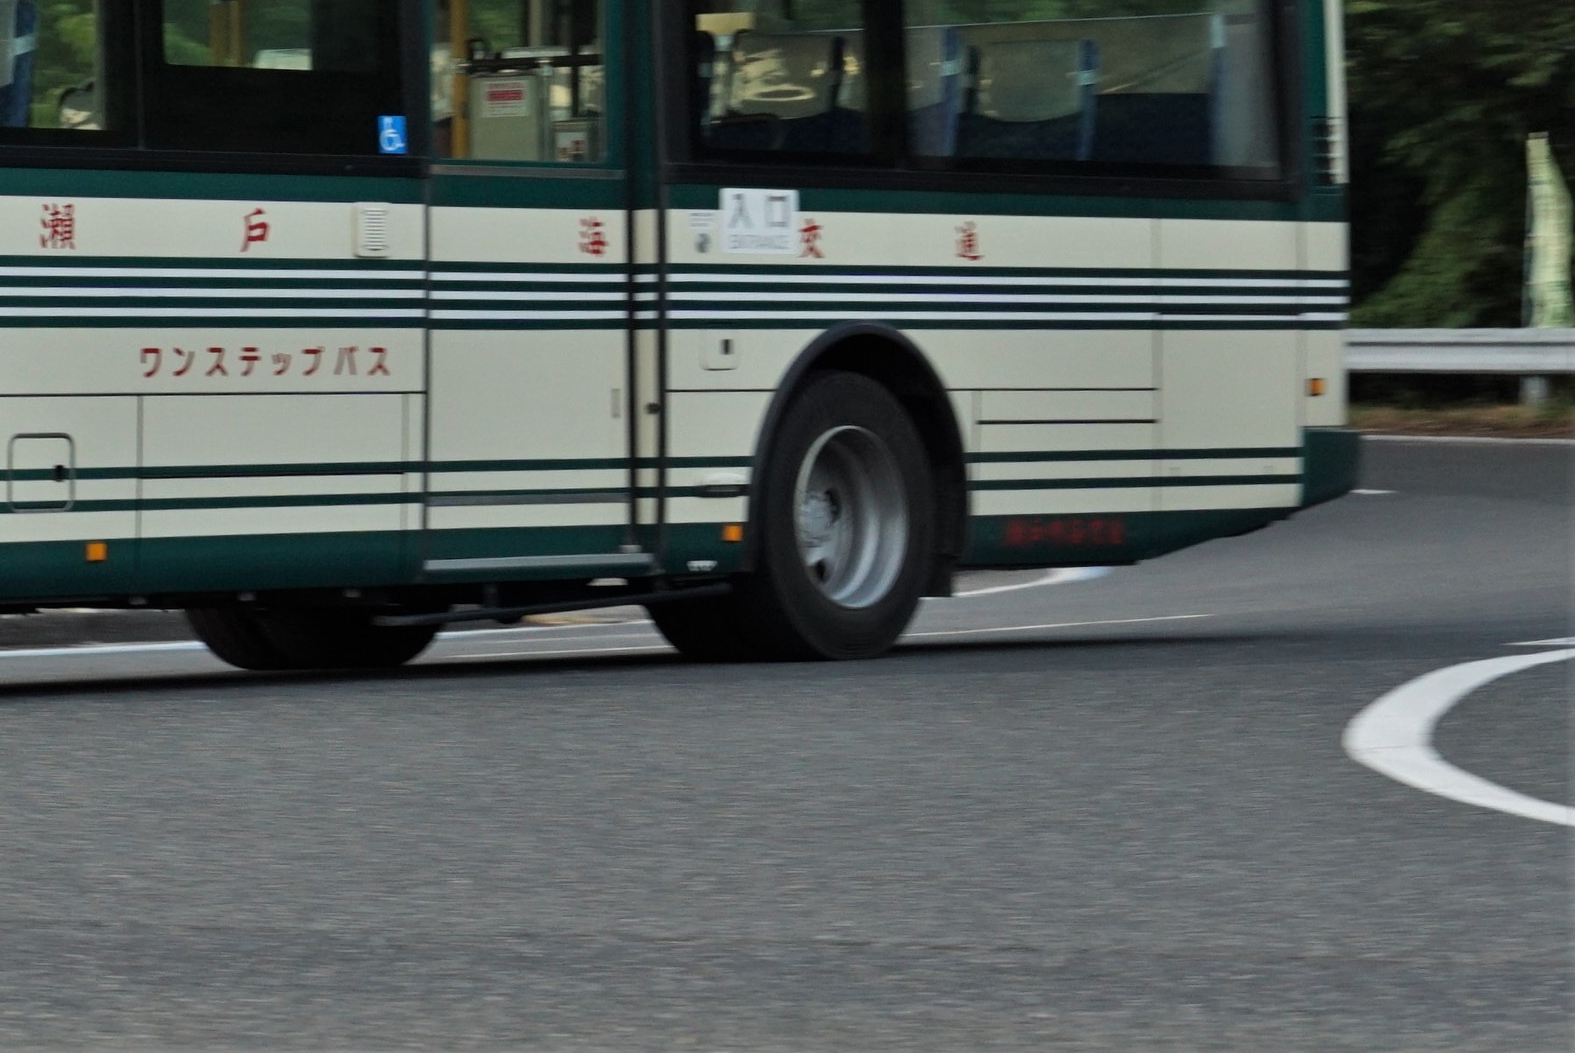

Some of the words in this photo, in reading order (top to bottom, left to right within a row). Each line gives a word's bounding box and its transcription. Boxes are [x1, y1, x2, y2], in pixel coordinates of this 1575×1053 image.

[728, 194, 791, 227] 入口
[140, 346, 391, 377] ワンステップバス
